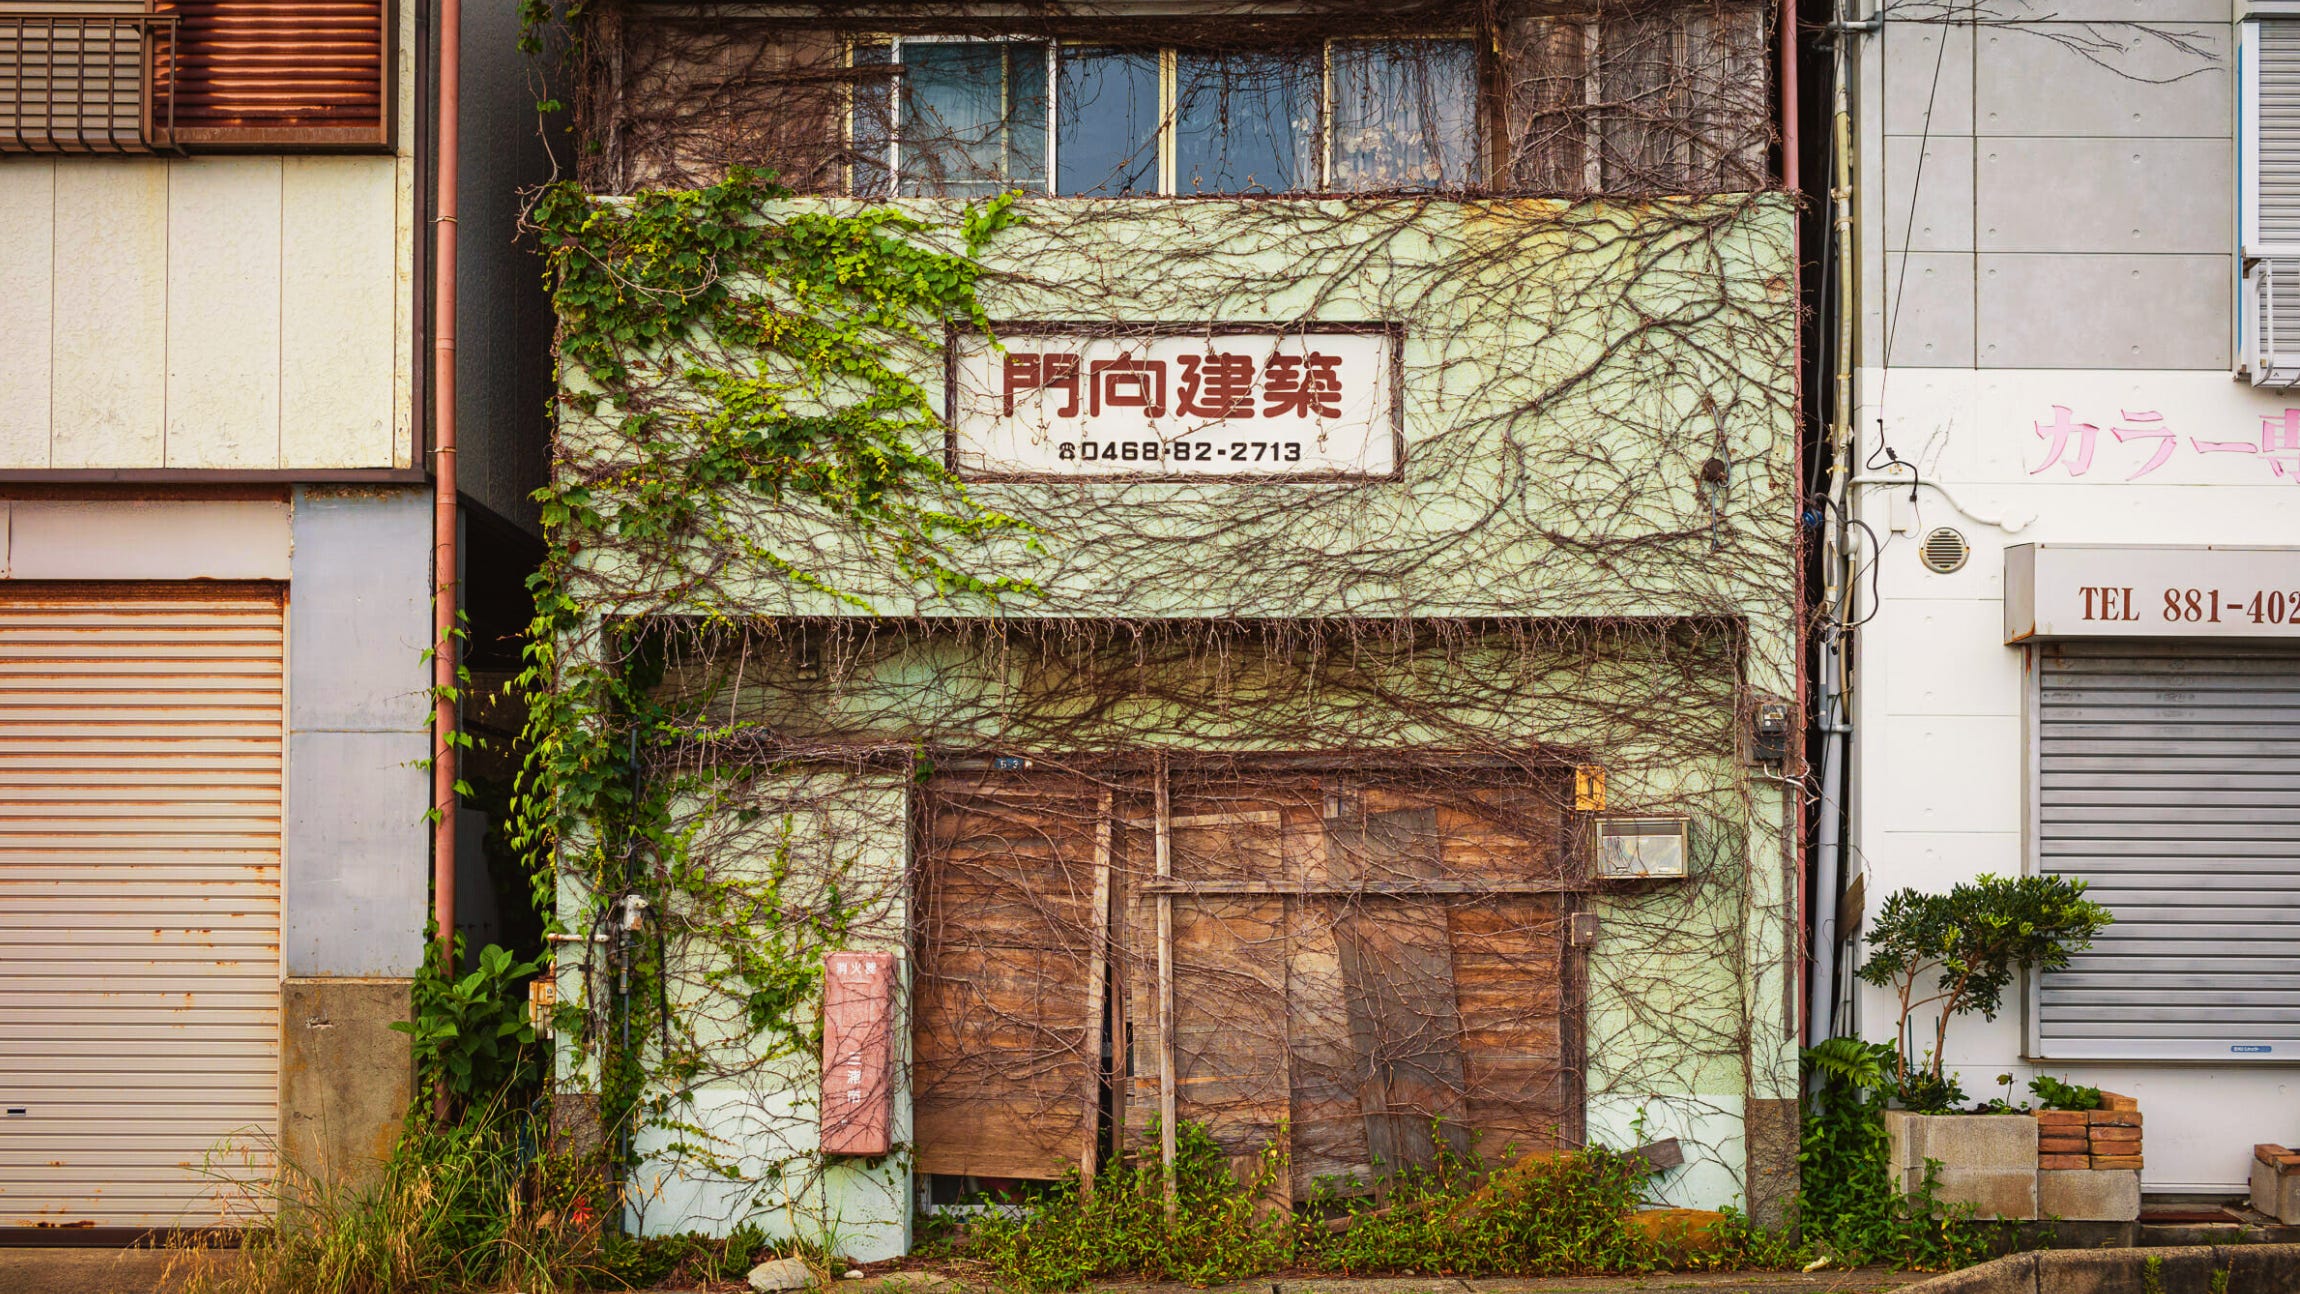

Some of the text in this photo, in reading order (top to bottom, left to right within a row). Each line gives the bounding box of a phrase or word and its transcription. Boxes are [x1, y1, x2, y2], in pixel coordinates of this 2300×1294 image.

[1003, 351, 1343, 419] 門向建築
[1081, 442, 1301, 461] 0468-82-2713
[2079, 587, 2141, 622] TEL
